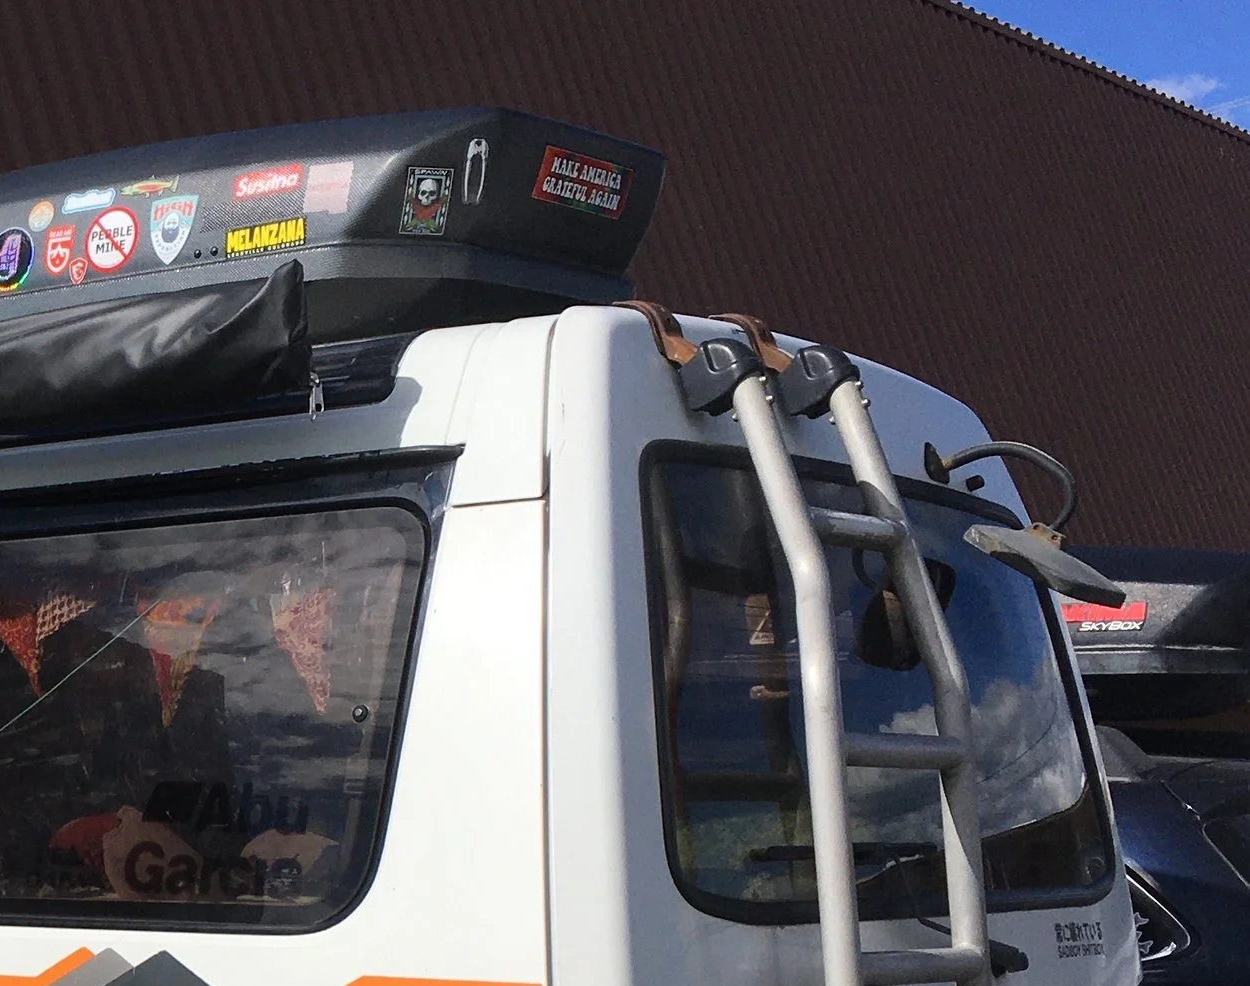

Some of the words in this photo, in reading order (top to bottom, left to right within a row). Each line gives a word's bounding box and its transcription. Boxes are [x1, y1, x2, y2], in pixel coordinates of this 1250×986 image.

[414, 168, 448, 176] SPAWN
[551, 156, 579, 177] MAKE
[579, 167, 622, 190] AMERICA
[542, 176, 588, 202] GRATEFUL
[588, 188, 622, 211] AGAIN
[227, 217, 305, 254] MELANZANA
[1078, 621, 1144, 632] SKYBOX
[196, 781, 308, 834] Abu
